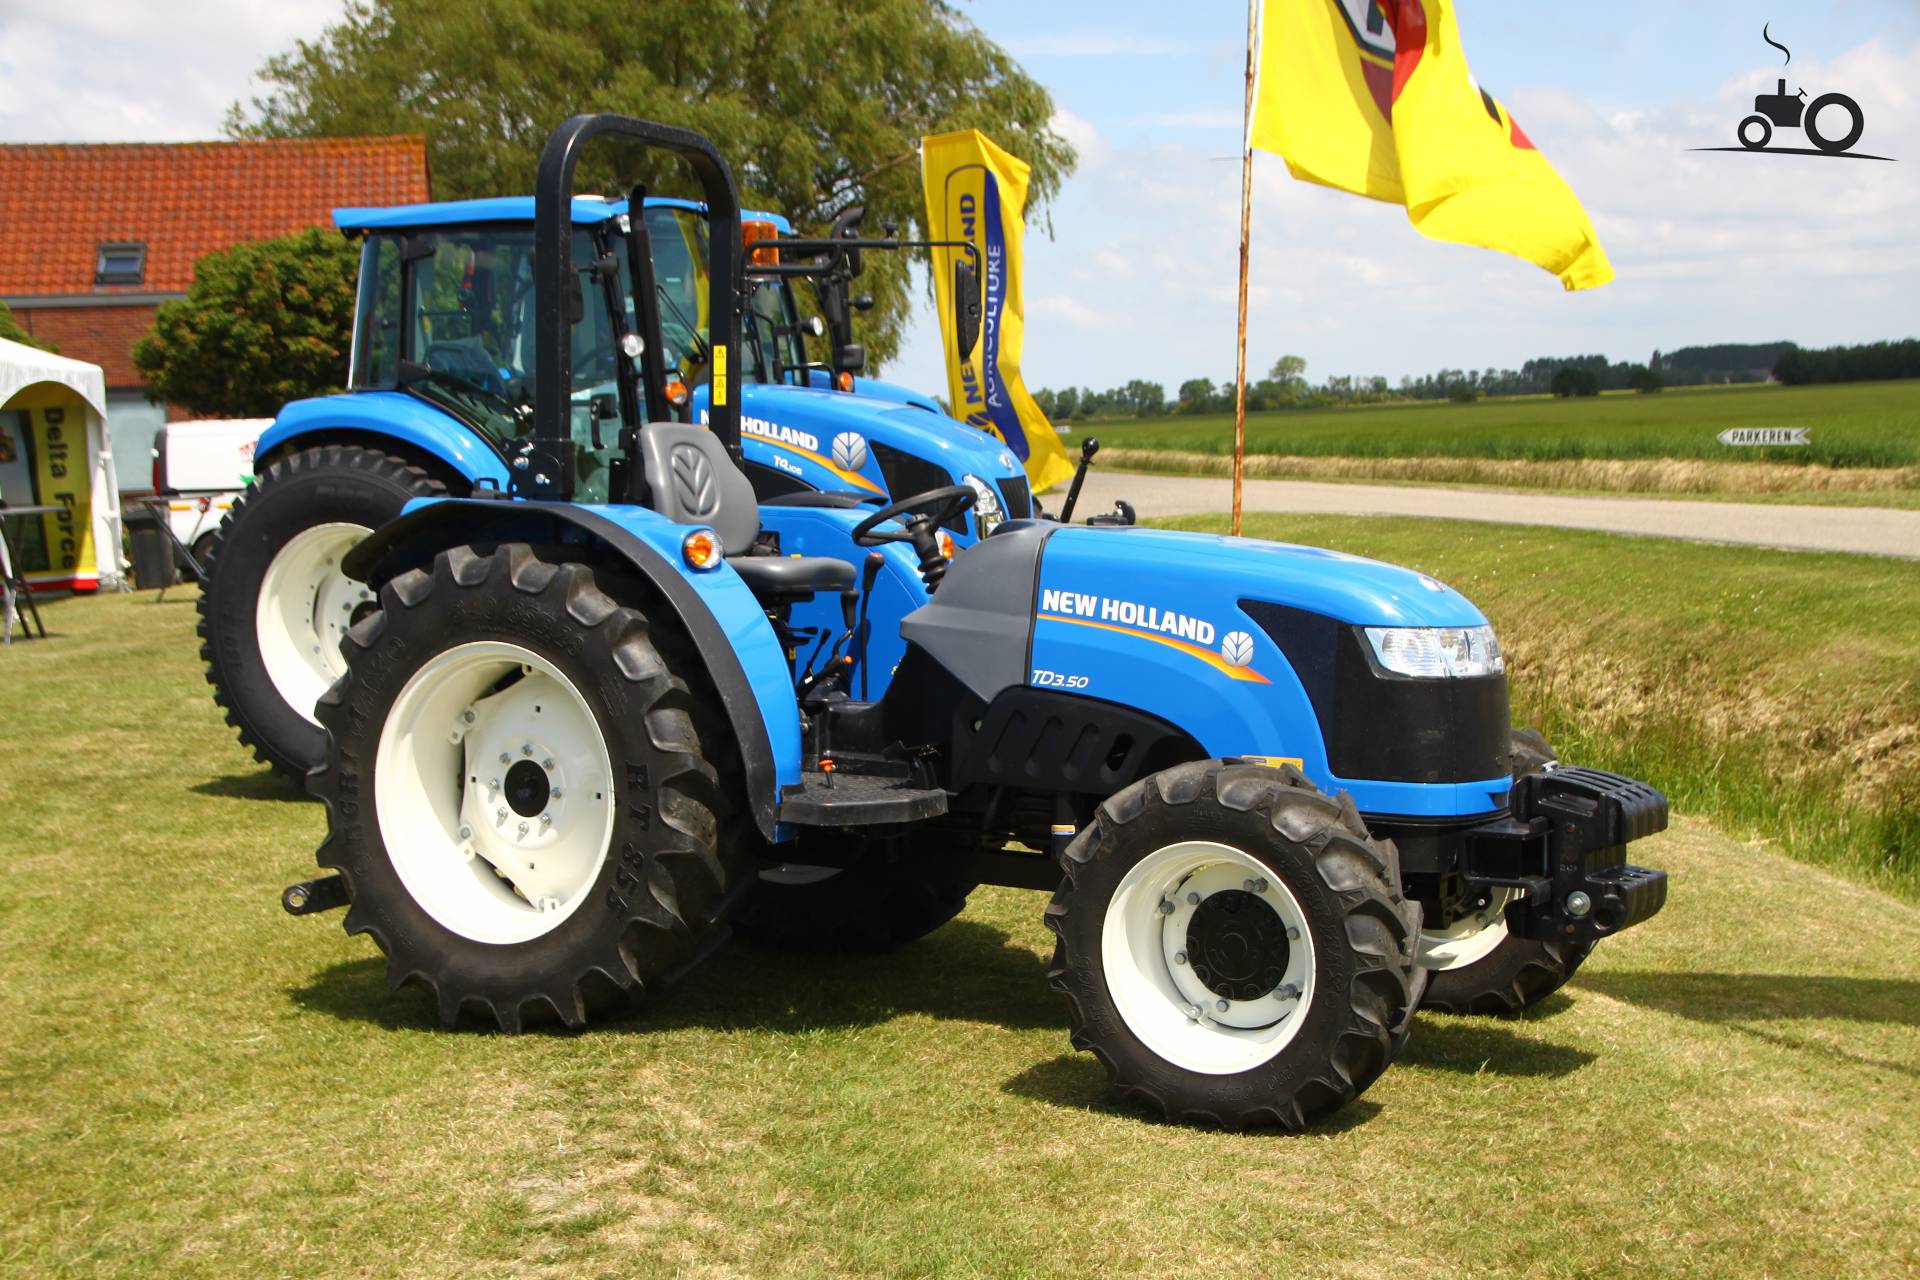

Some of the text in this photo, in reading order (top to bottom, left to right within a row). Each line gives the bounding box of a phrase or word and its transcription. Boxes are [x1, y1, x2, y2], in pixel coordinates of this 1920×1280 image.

[741, 415, 819, 452] HOLLAND
[1731, 430, 1792, 443] PARKEREN
[45, 408, 76, 569] Delta Force
[1042, 589, 1216, 645] NEW HOLLAND
[1032, 669, 1089, 689] TD3.50
